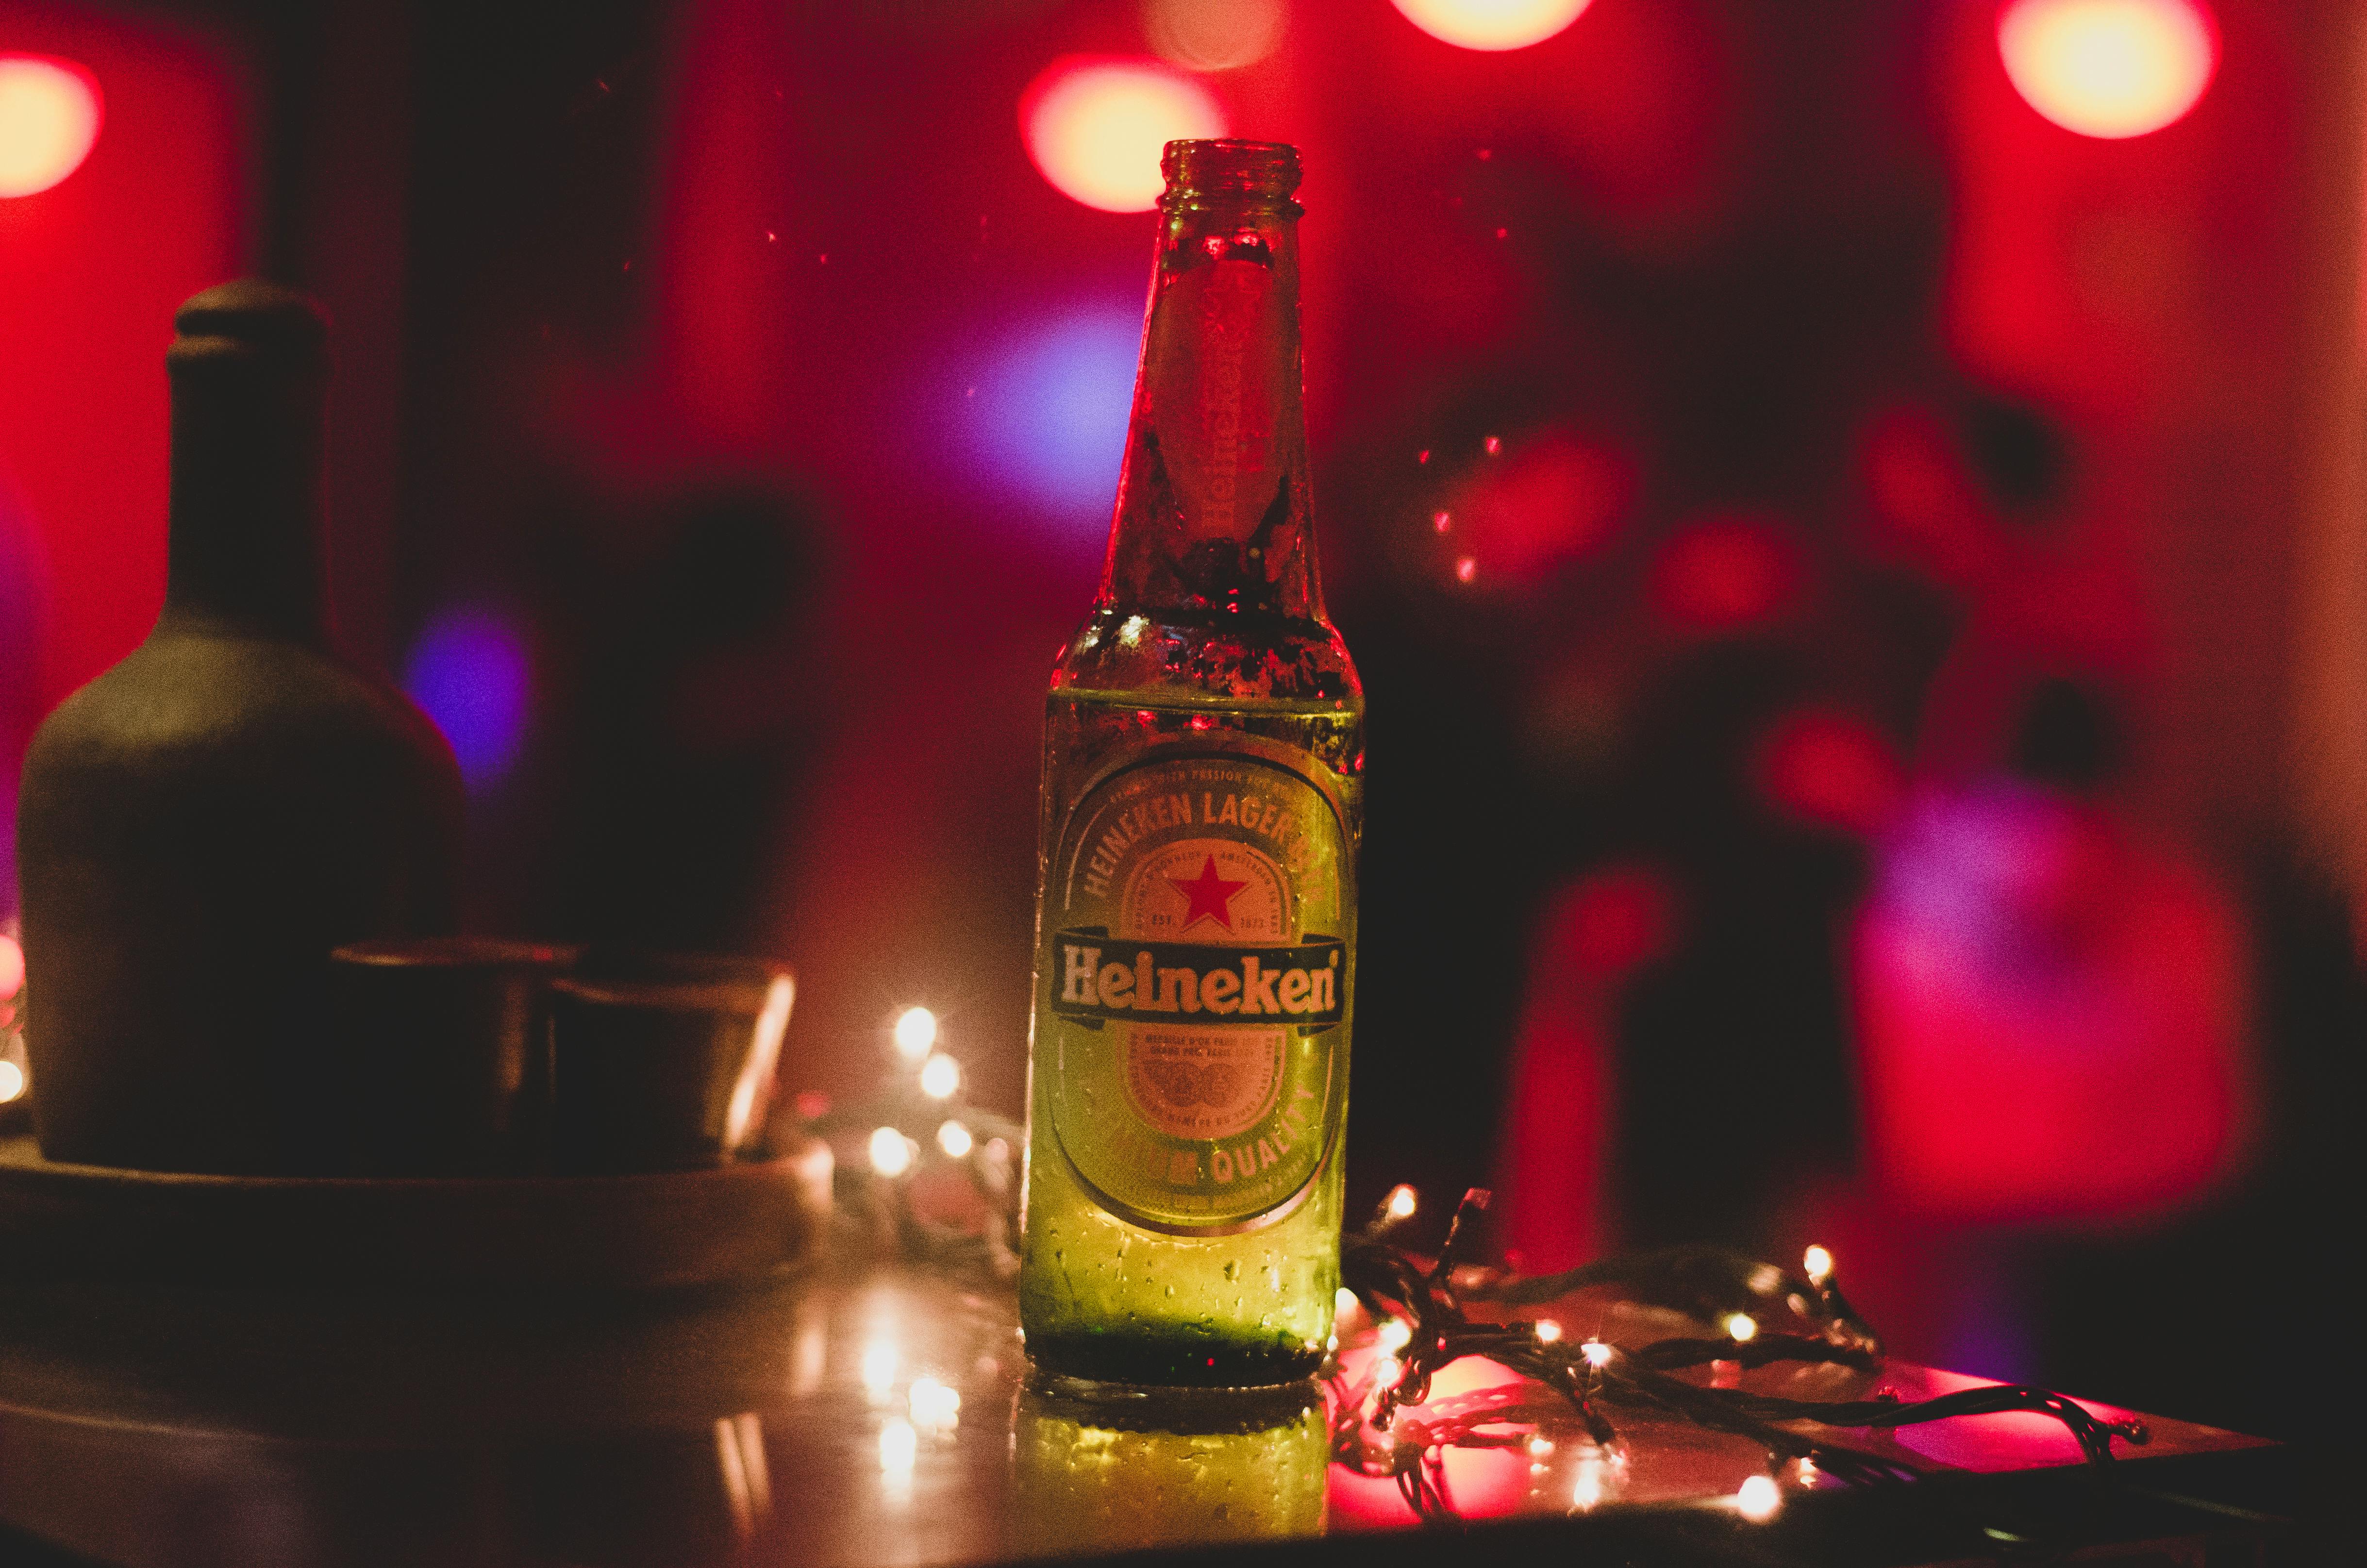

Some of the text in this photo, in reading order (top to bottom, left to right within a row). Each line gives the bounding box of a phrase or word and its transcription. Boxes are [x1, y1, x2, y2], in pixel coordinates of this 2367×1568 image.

[1083, 792, 1192, 896] HEINEKEN
[1203, 791, 1293, 845] LAGER
[1061, 945, 1339, 1015] Heineken
[1211, 1083, 1315, 1183] QUALITY
